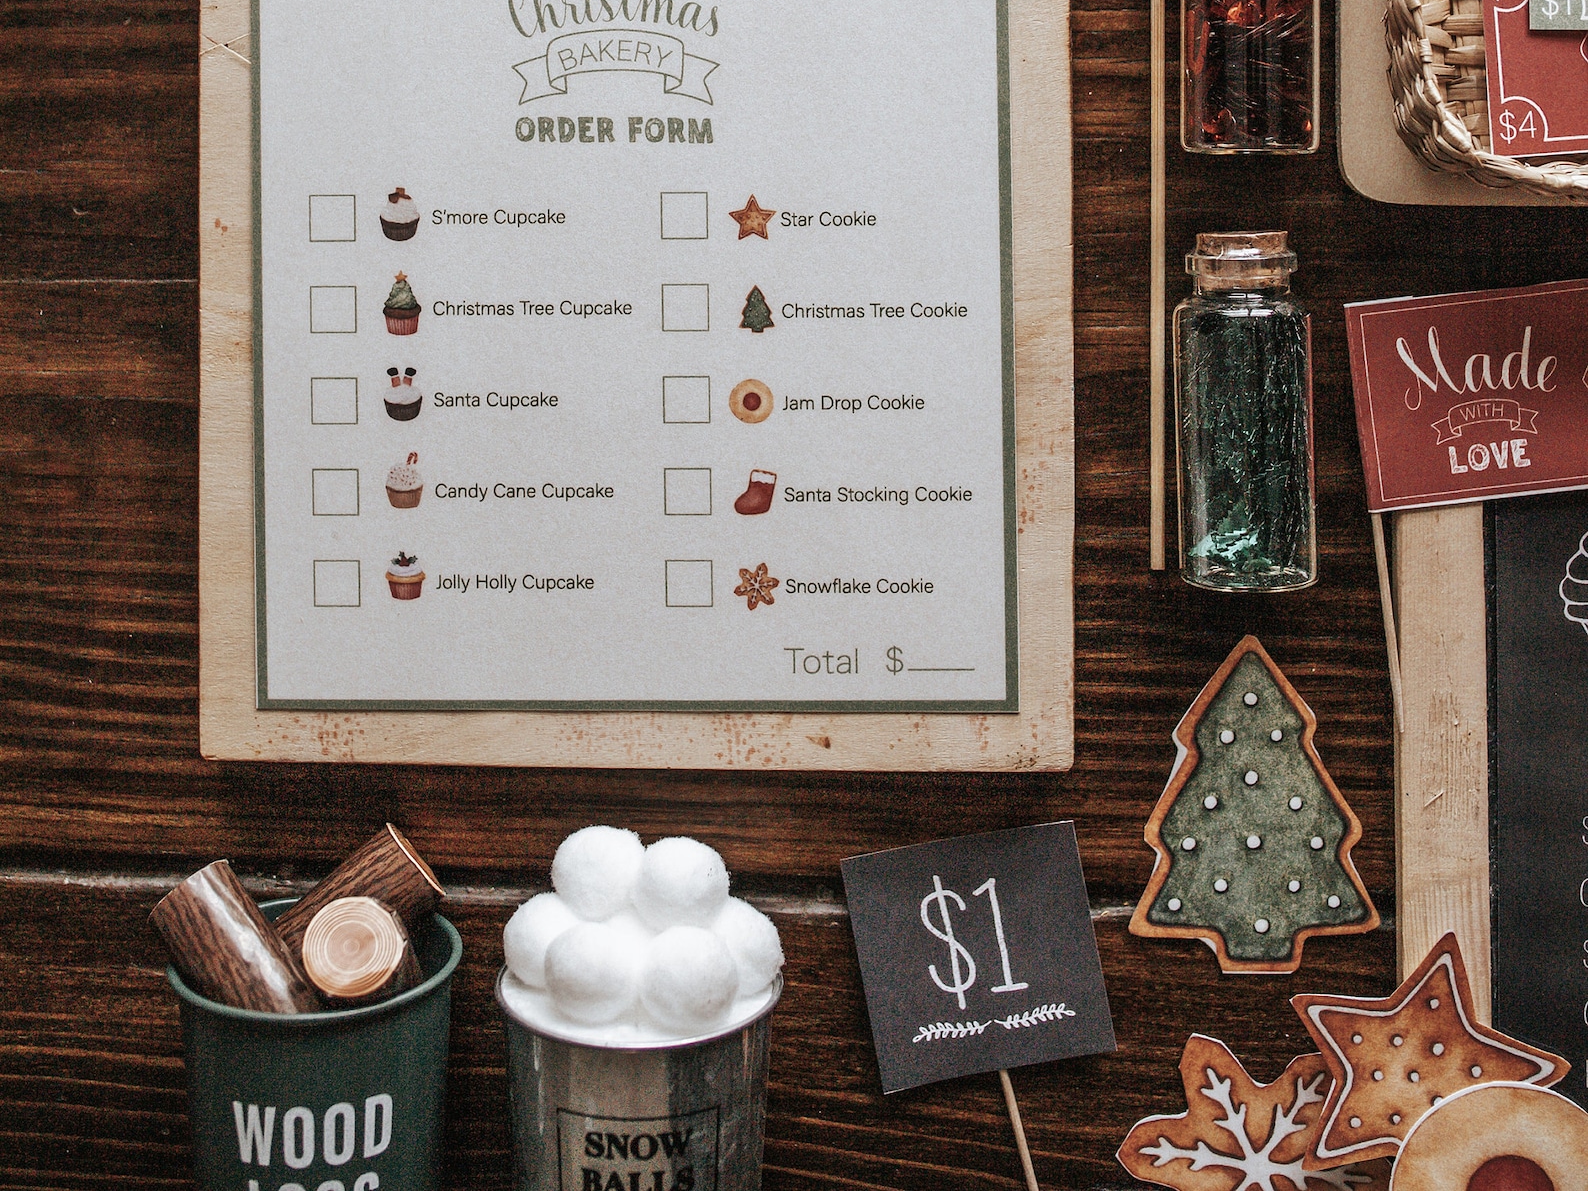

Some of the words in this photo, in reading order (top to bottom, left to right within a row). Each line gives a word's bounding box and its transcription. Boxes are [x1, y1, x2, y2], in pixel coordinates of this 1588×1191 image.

[557, 40, 672, 72] BAKERY
[515, 117, 615, 143] ORDER
[628, 117, 713, 144] FORM
[1499, 108, 1539, 144] $4
[432, 209, 488, 225] S'more
[493, 209, 566, 227] Cupcake
[781, 212, 814, 227] Star
[819, 211, 876, 227] Cookie
[433, 301, 514, 316] Christmas
[520, 301, 554, 315] Tree
[560, 299, 632, 318] Cupcake
[782, 303, 865, 319] Christmas
[870, 303, 905, 318] Tree
[910, 302, 968, 318] Cookie
[1396, 325, 1558, 411] Made
[434, 392, 480, 407] Santa
[486, 391, 558, 410] Cupcake
[783, 396, 814, 411] Jam
[821, 395, 862, 413] Drop
[867, 395, 925, 410] Cookie
[1459, 403, 1504, 422] WITH
[1448, 438, 1532, 475] LOVE
[435, 483, 488, 502] Candy
[493, 483, 536, 498] Cane
[542, 483, 614, 501] Cupcake
[784, 487, 831, 502] Santa
[838, 487, 908, 506] Stocking
[915, 486, 972, 502] Cookie
[436, 574, 470, 594] Jolly
[476, 574, 517, 594] Holly
[522, 574, 594, 593] Cupcake
[786, 578, 871, 594] Snowflake
[876, 578, 934, 594] Cookie
[783, 648, 858, 674] Total
[921, 876, 1028, 1009] $1
[233, 1094, 392, 1168] WOOD
[584, 1128, 693, 1160] SNOW
